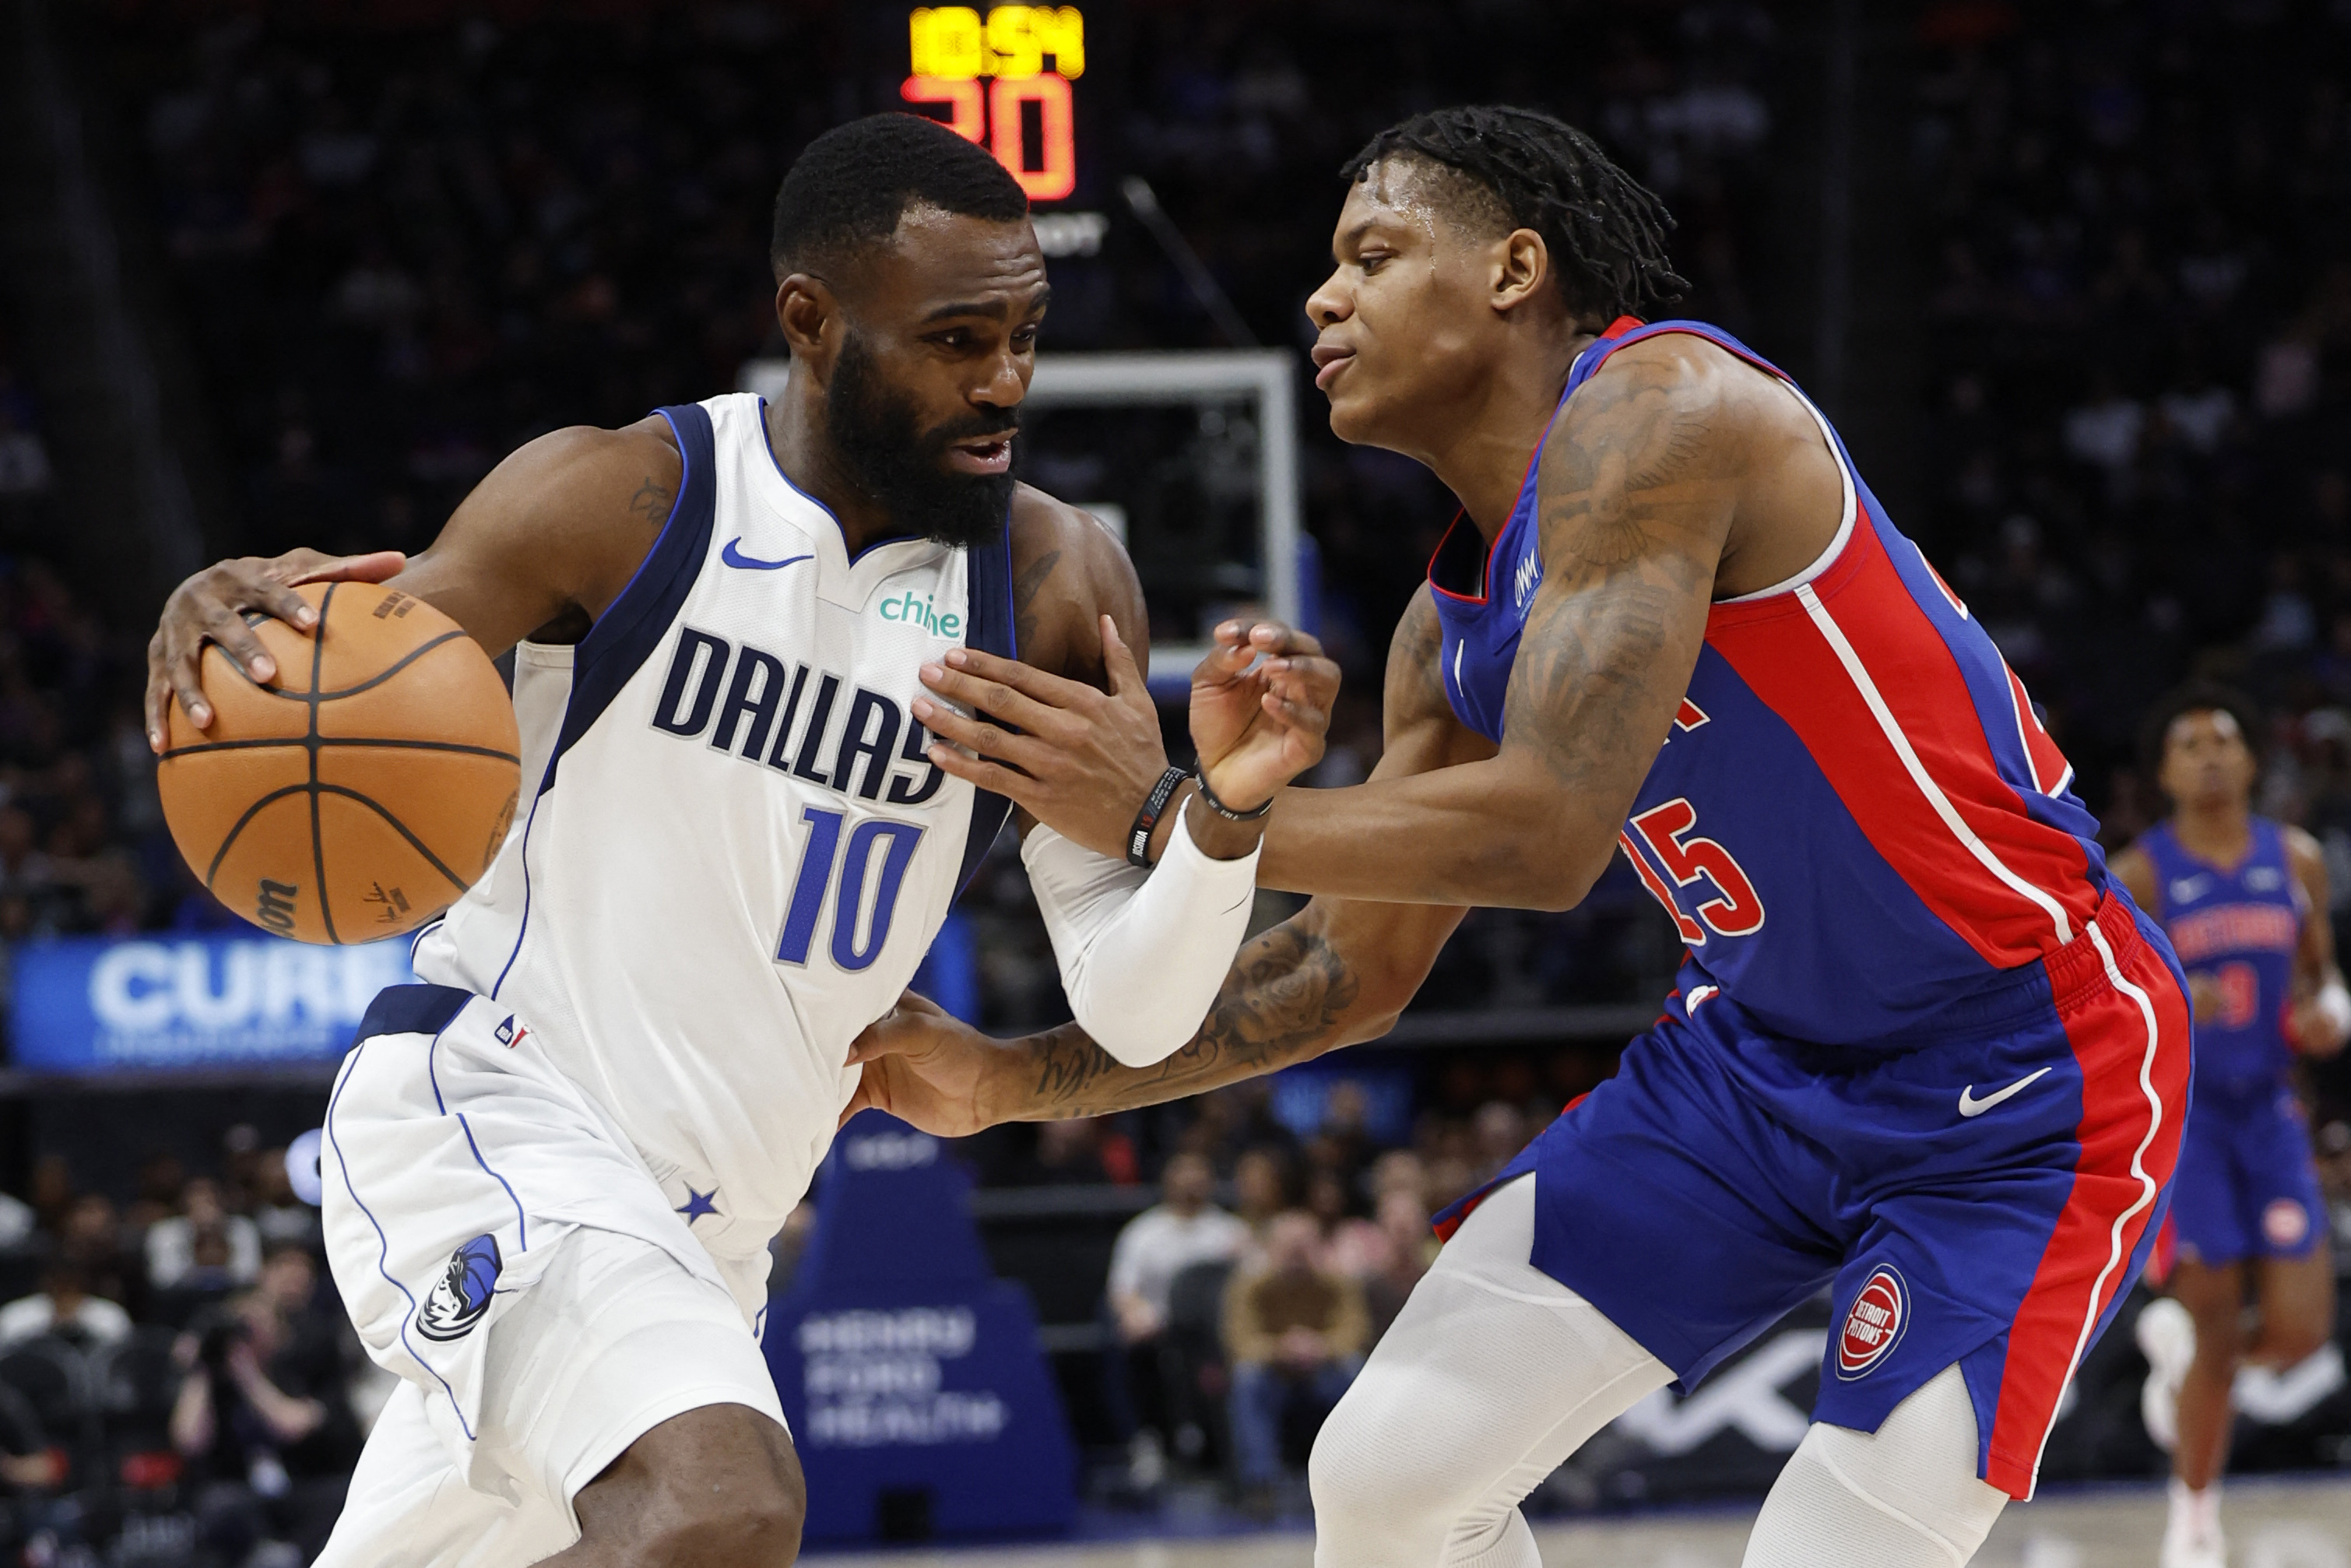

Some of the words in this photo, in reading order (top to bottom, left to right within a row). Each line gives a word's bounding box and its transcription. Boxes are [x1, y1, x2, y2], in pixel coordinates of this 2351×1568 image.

[648, 622, 947, 808] DALLAS
[1132, 830, 1148, 857] JOSHUA
[772, 802, 930, 975] 10
[1856, 1300, 1891, 1327] DETROIT
[1847, 1318, 1883, 1345] PISTONS
